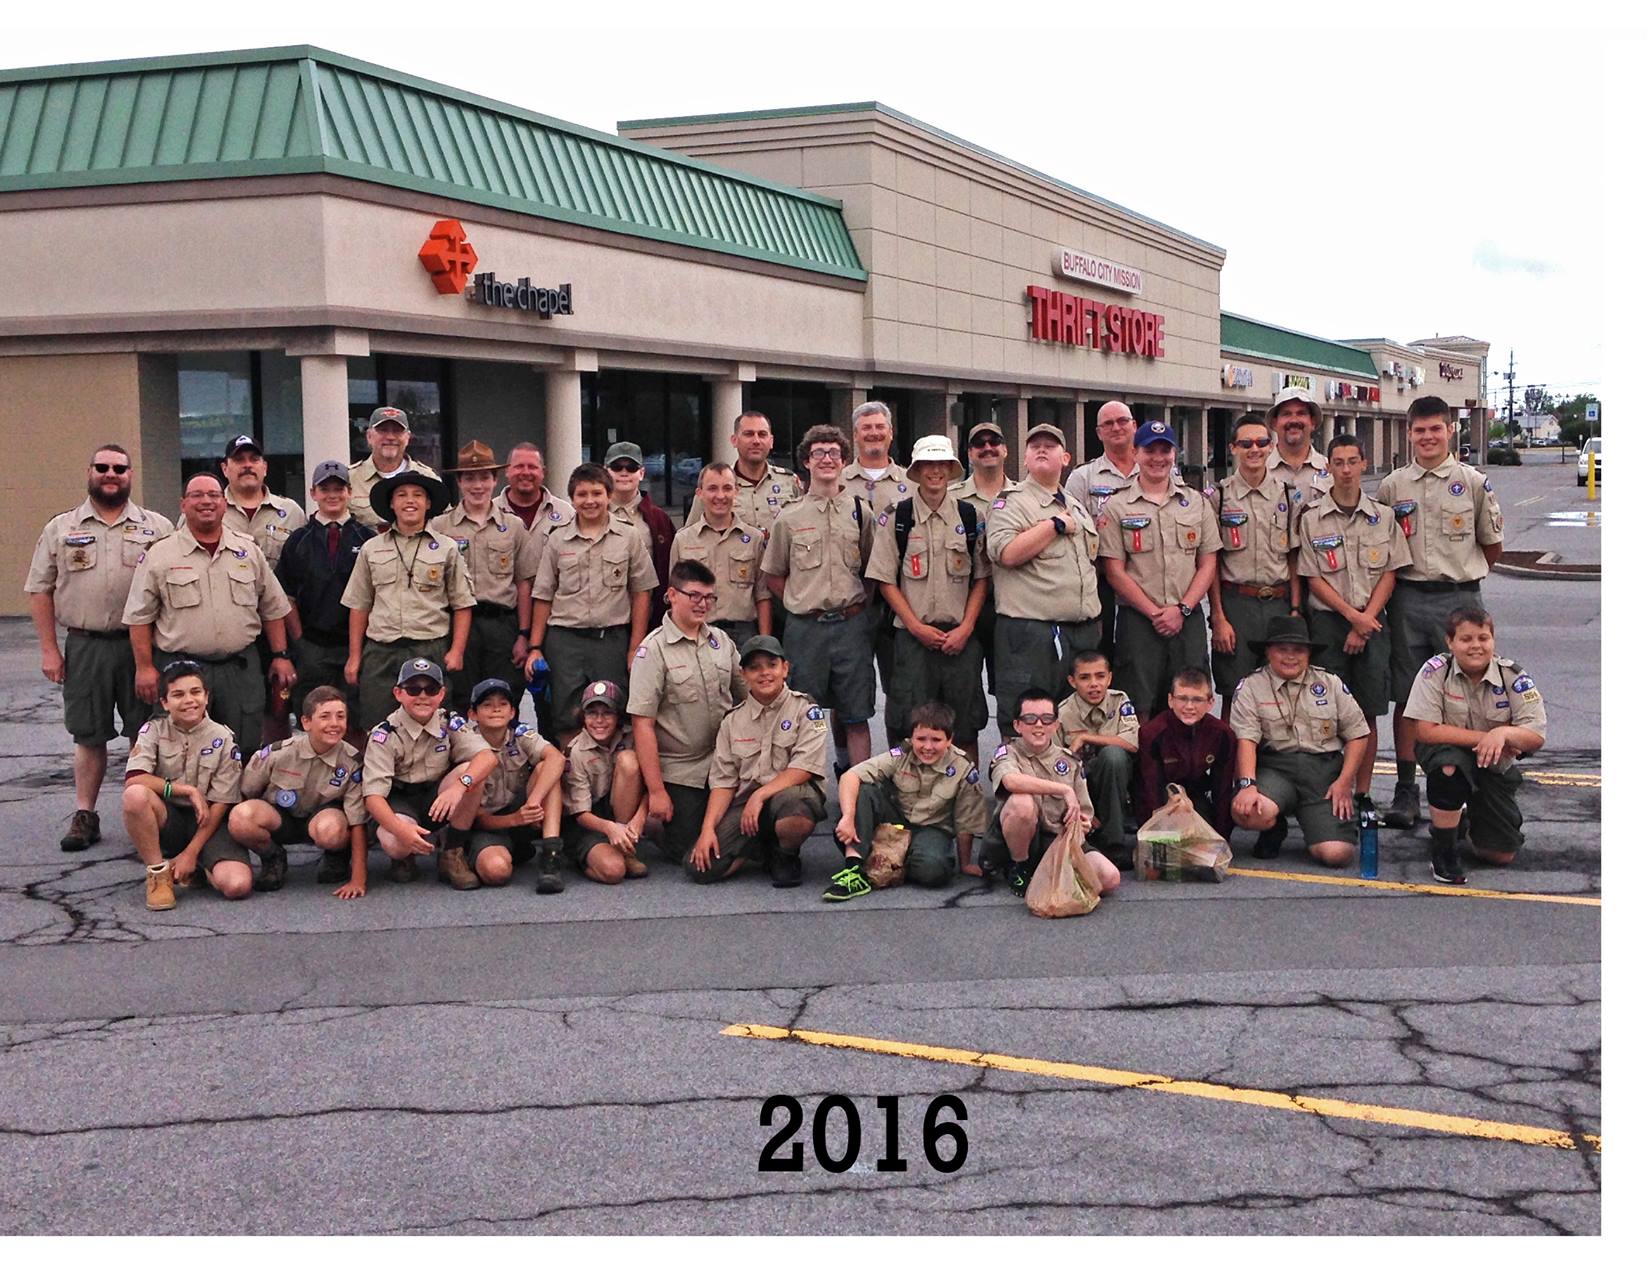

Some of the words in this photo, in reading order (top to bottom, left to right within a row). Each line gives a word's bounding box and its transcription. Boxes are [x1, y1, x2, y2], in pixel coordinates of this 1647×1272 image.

[1063, 252, 1096, 277] BUFFALO
[1097, 262, 1113, 282] CITY
[1114, 267, 1141, 290] MISSION
[477, 272, 515, 307] the
[517, 277, 573, 319] chapel
[1027, 285, 1106, 350] THRIFT
[1106, 304, 1165, 358] STORE
